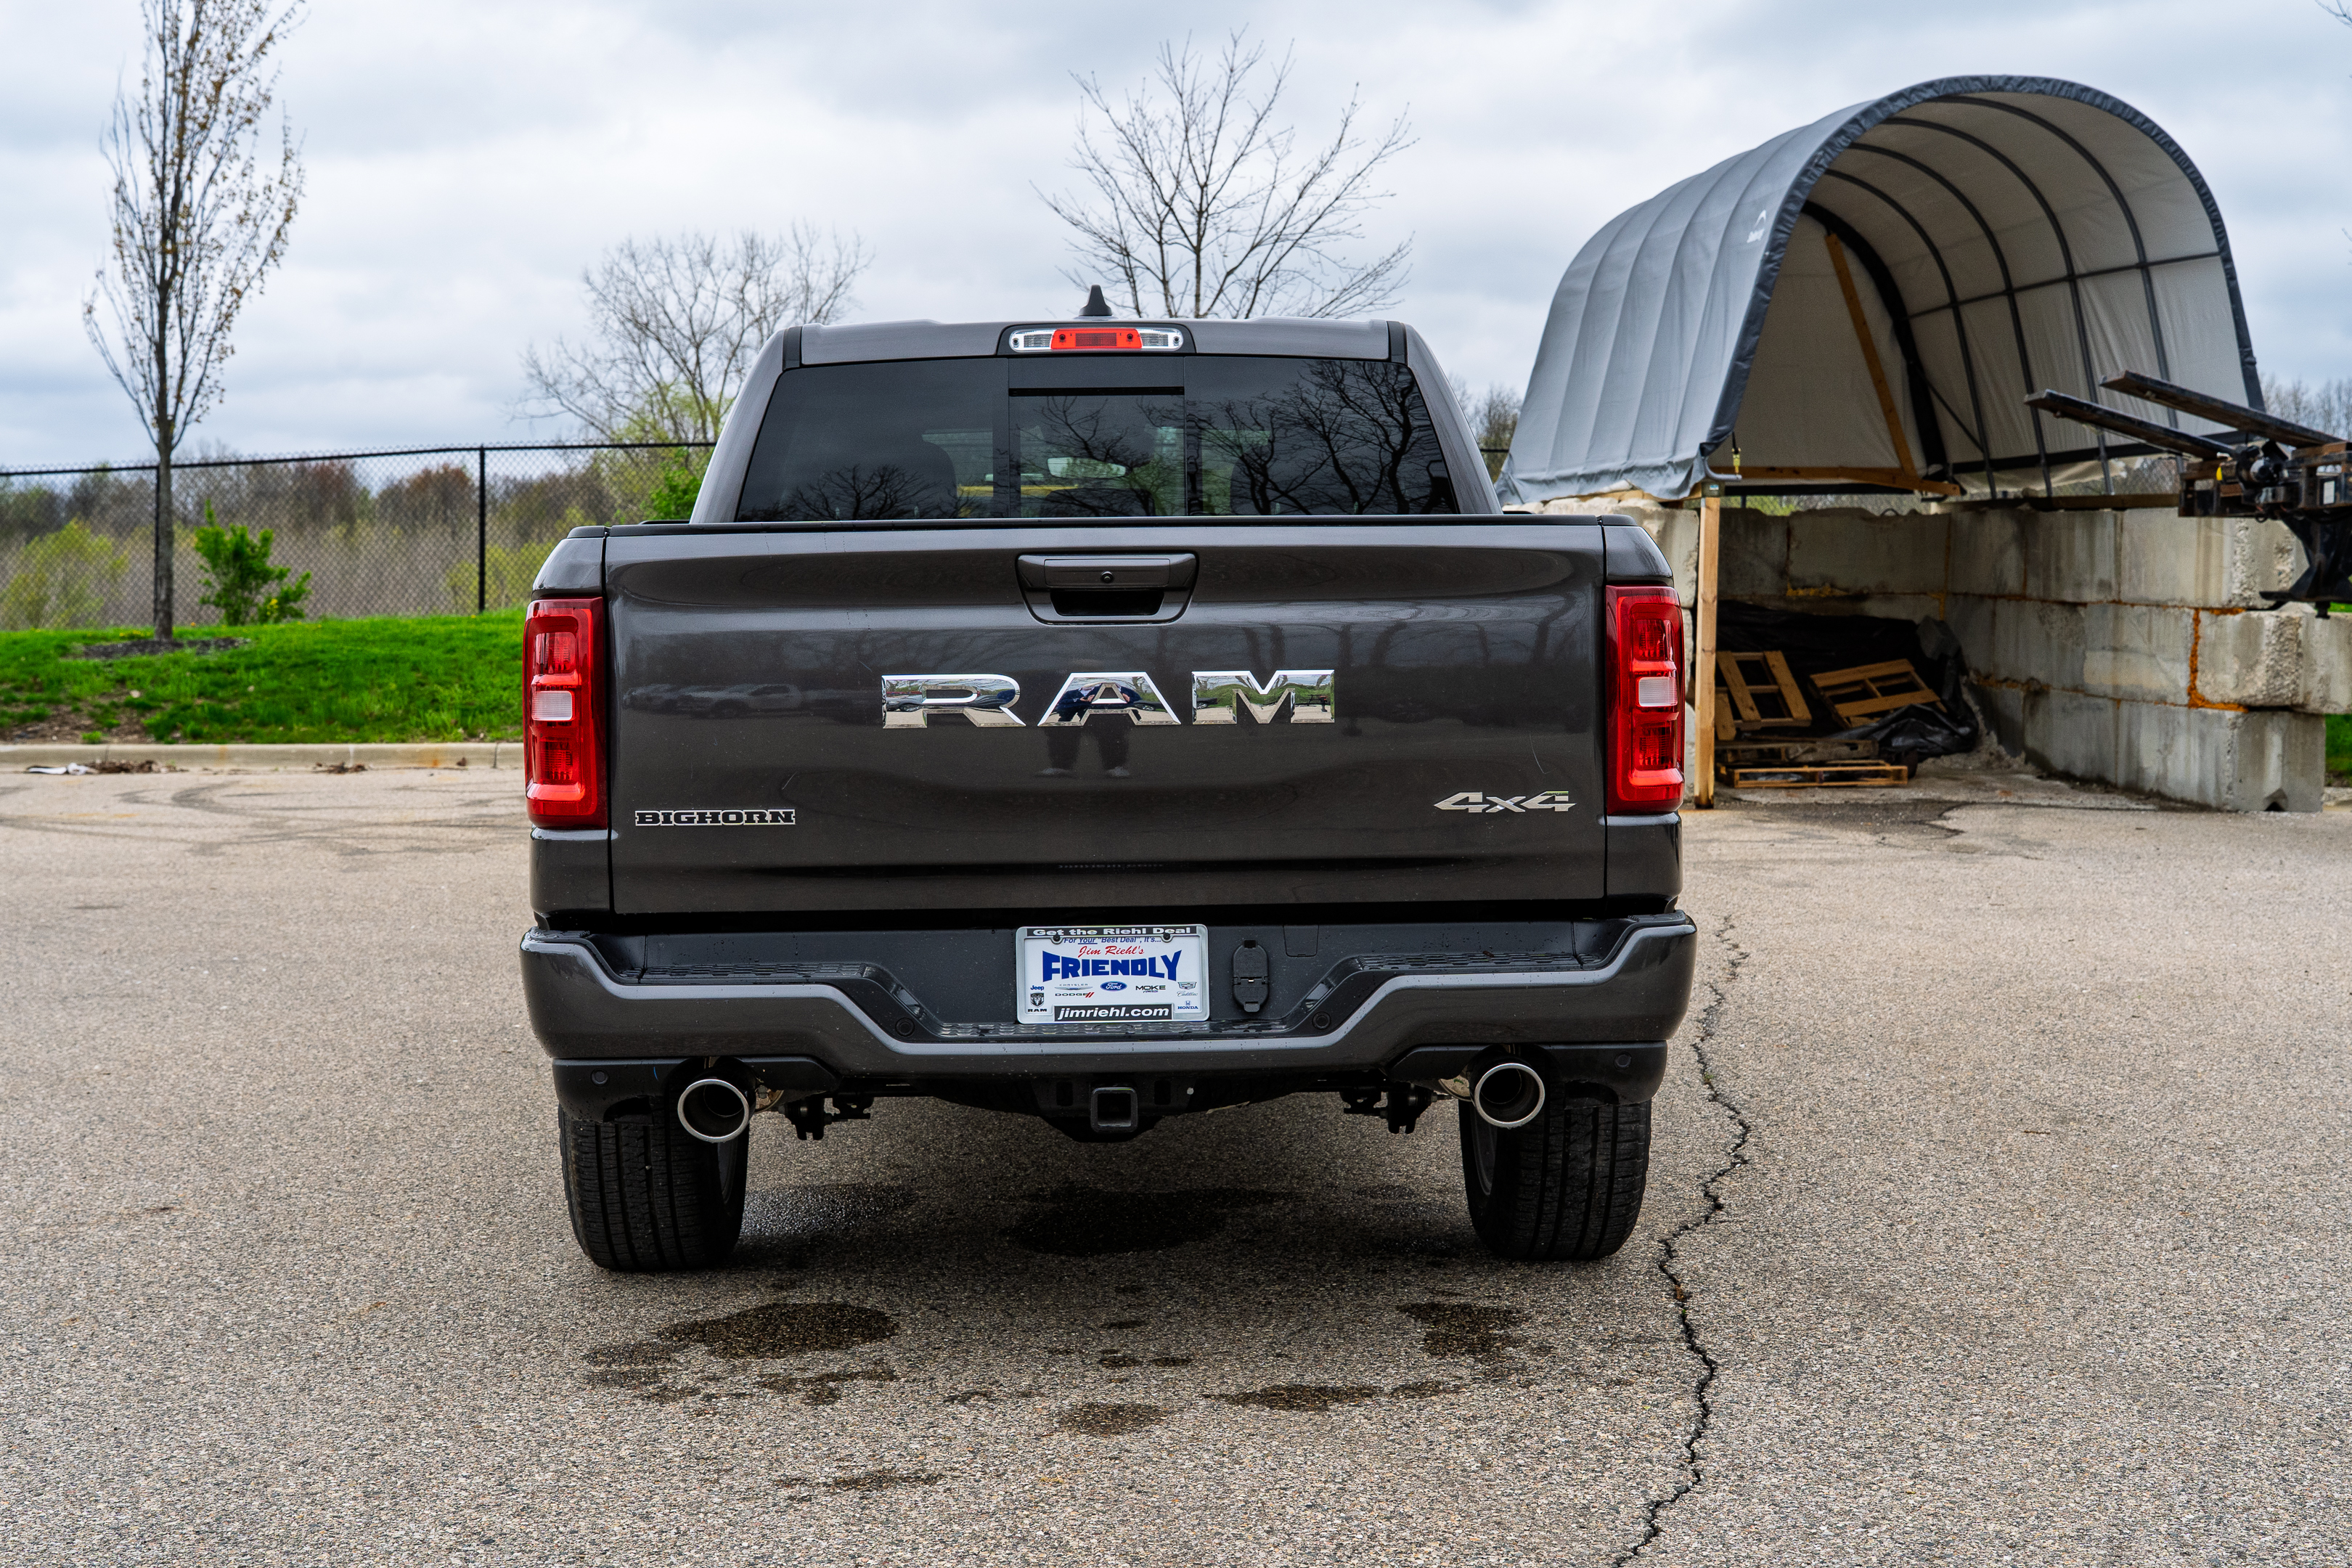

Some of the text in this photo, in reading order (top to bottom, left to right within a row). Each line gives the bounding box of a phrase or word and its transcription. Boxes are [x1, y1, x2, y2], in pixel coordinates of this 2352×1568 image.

[881, 669, 1335, 729] RAM
[1434, 791, 1577, 813] 4x4
[635, 809, 796, 826] BIGHORN
[1078, 946, 1144, 957] Jim Riehl's
[1042, 950, 1183, 982] FRIENDLY
[1057, 1007, 1169, 1020] jimriehl.com
